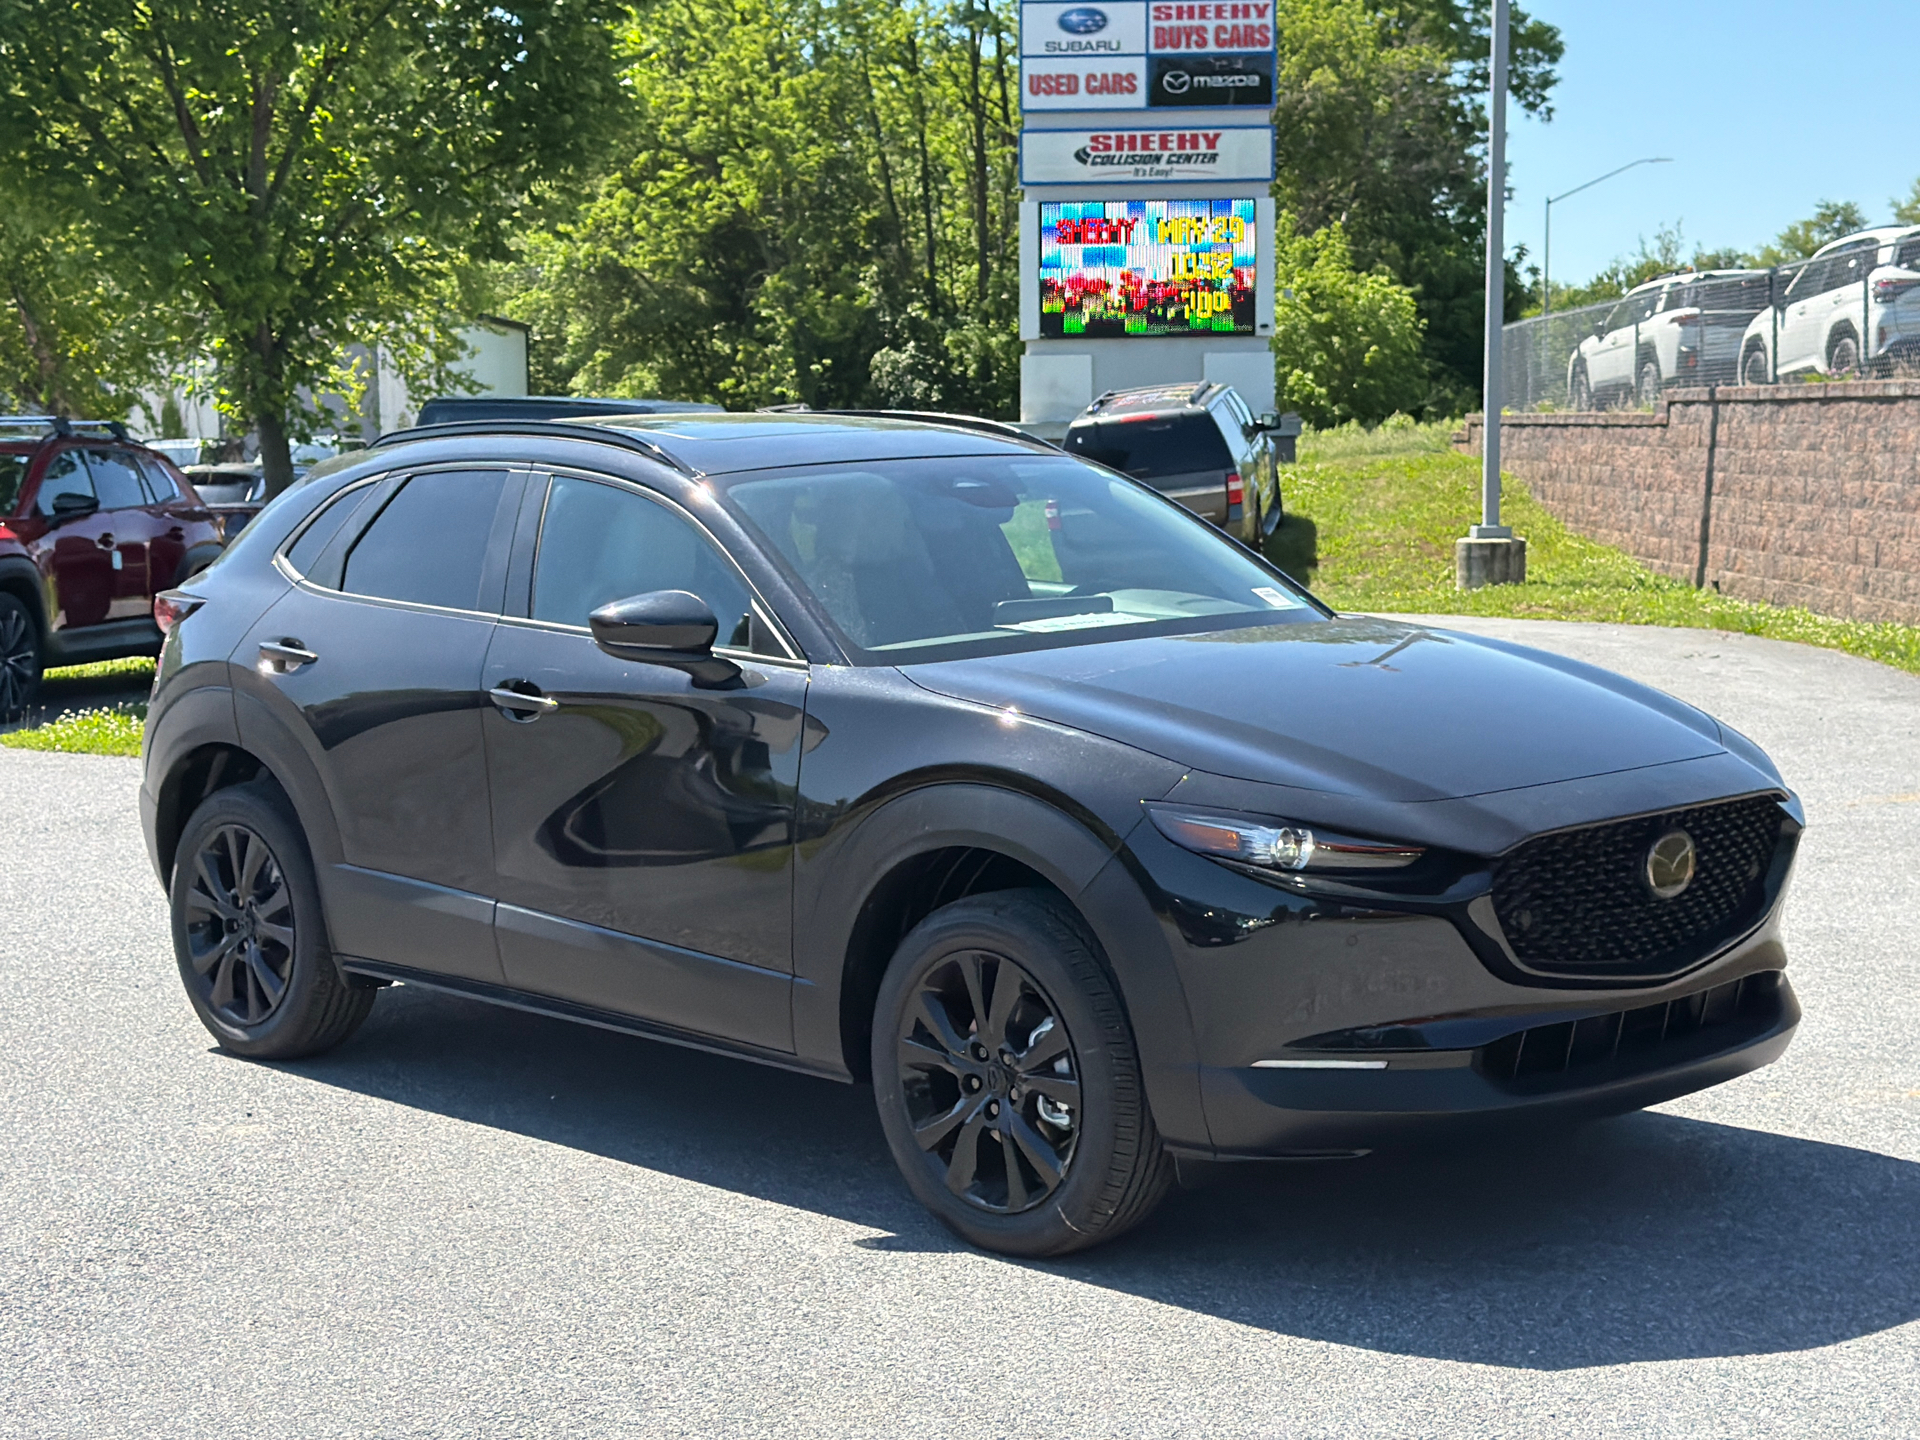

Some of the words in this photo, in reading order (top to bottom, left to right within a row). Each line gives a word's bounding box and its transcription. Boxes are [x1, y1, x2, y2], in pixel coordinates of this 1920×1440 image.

[1153, 3, 1270, 21] SHEEHY
[1154, 26, 1207, 49] BUYS
[1214, 24, 1270, 48] CARS
[1045, 40, 1120, 52] SUBARU
[1028, 74, 1079, 96] USED
[1085, 73, 1137, 94] CARS
[1193, 75, 1260, 88] mazda
[1089, 132, 1222, 152] SHEEHY
[1091, 153, 1163, 166] COLLISION
[1166, 153, 1218, 165] CENTER
[1133, 167, 1147, 177] It's
[1149, 167, 1173, 178] Easy!
